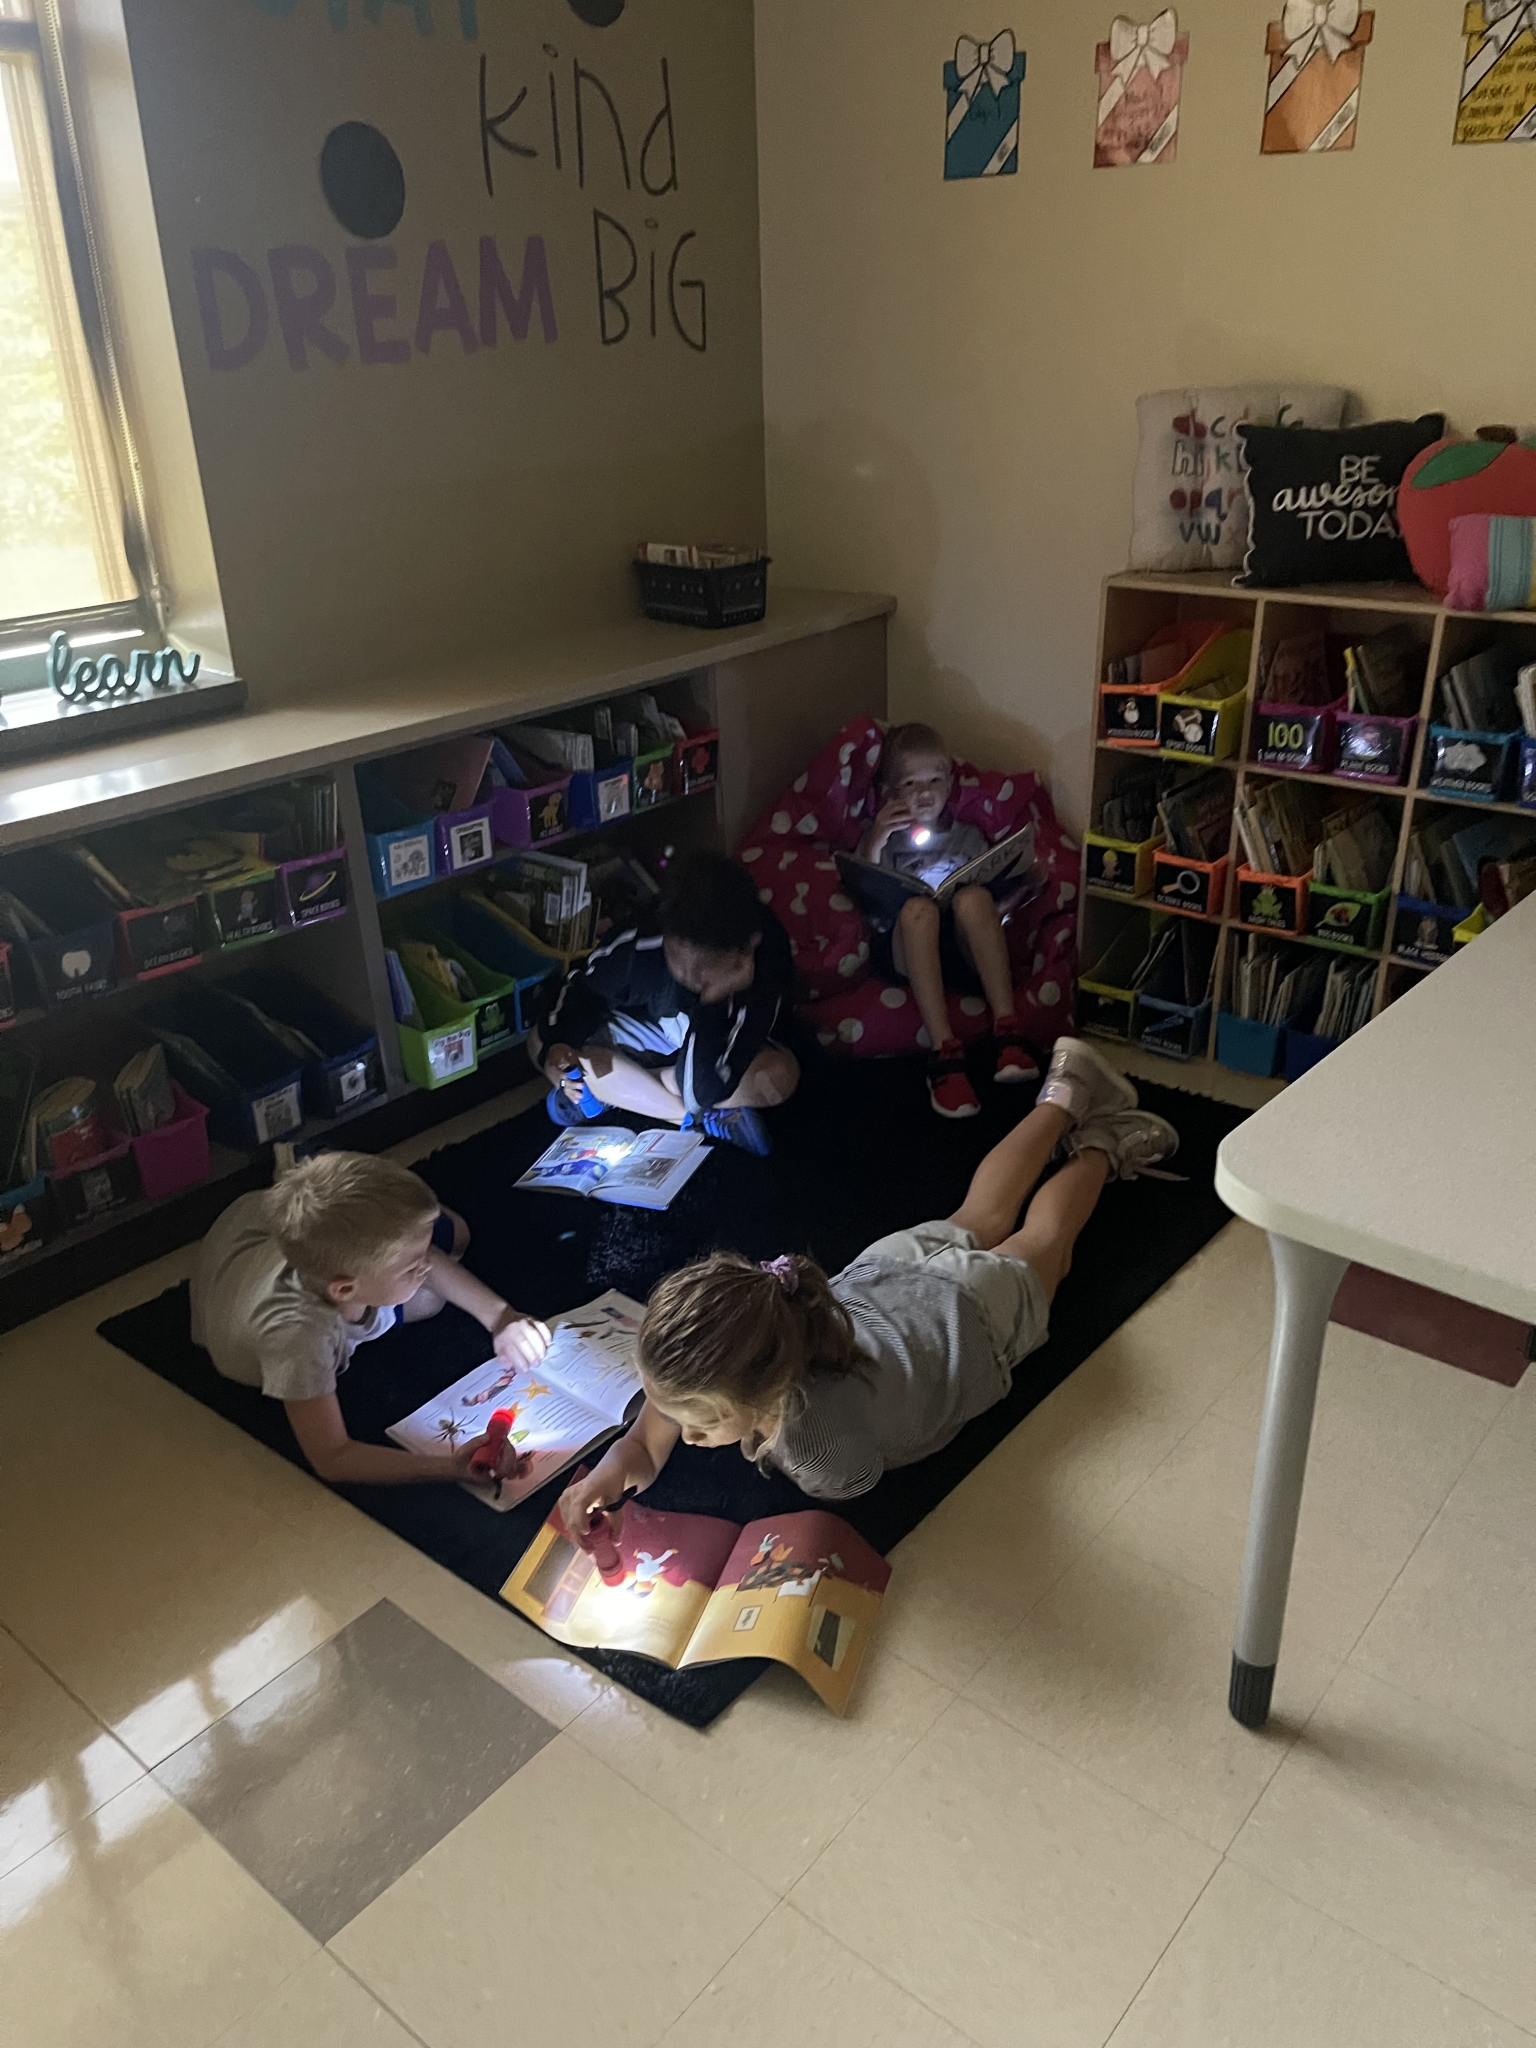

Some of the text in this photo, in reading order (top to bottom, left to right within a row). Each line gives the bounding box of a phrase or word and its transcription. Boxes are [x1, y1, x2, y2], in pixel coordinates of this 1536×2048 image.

[478, 43, 679, 199] kind
[190, 234, 559, 373] DREAM
[1339, 454, 1382, 486] BE
[1295, 510, 1401, 541] TODA
[45, 629, 201, 702] learn
[1267, 721, 1305, 750] 100
